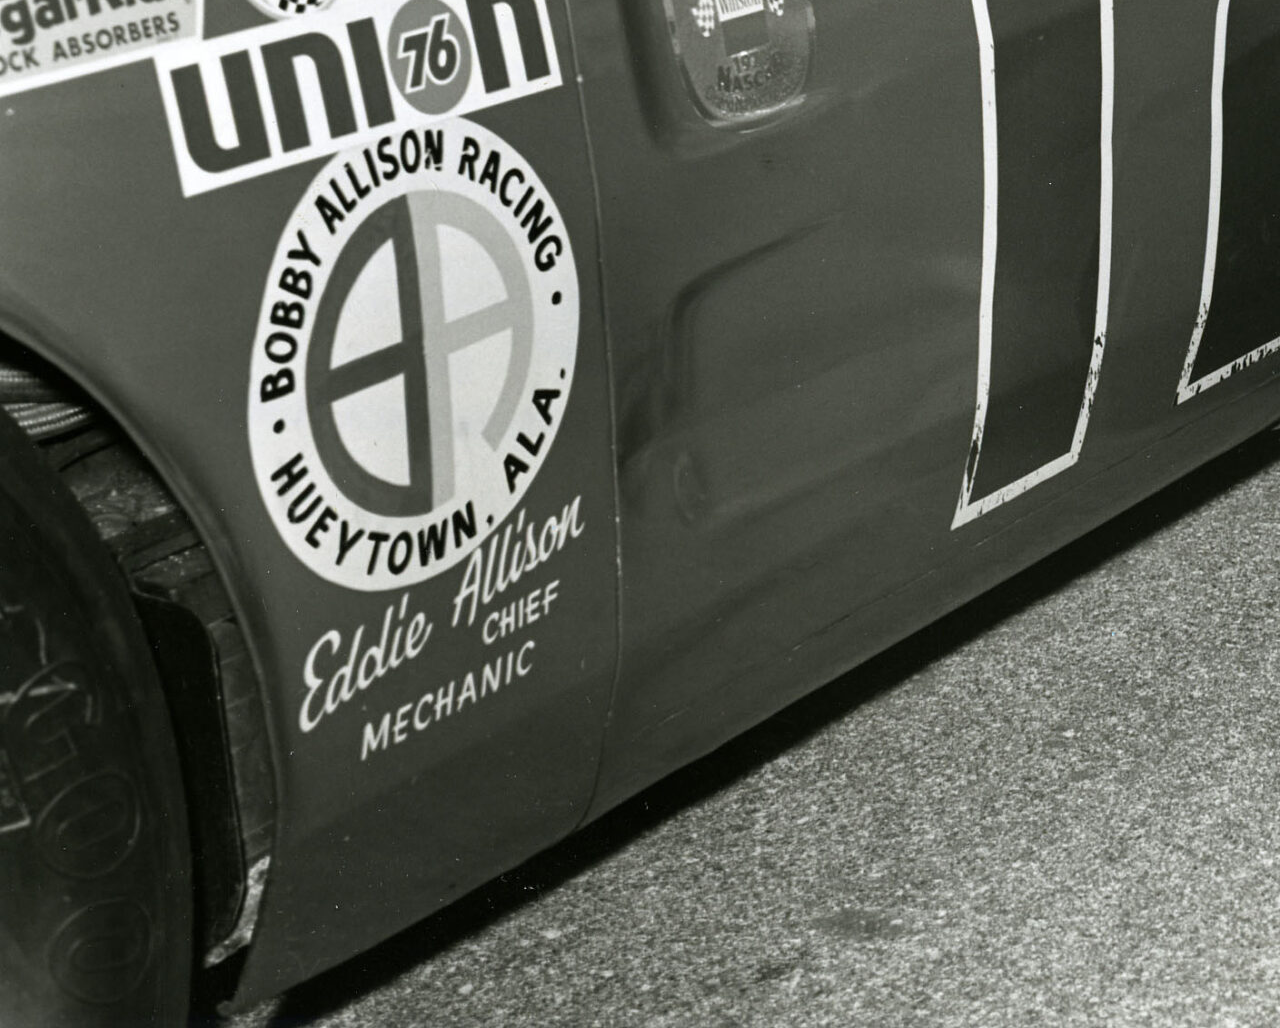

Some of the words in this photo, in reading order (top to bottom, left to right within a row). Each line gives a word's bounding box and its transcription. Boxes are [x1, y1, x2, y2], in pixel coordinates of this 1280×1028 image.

[52, 12, 181, 62] ABSORBERS
[397, 12, 461, 94] 76
[260, 230, 322, 403] BOBBY
[314, 129, 445, 235] ALLISON
[457, 136, 564, 273] RACING
[299, 593, 433, 734] Eddie
[451, 494, 585, 628] Allison
[481, 579, 561, 645] CHIEF
[360, 641, 536, 761] MECHANIC
